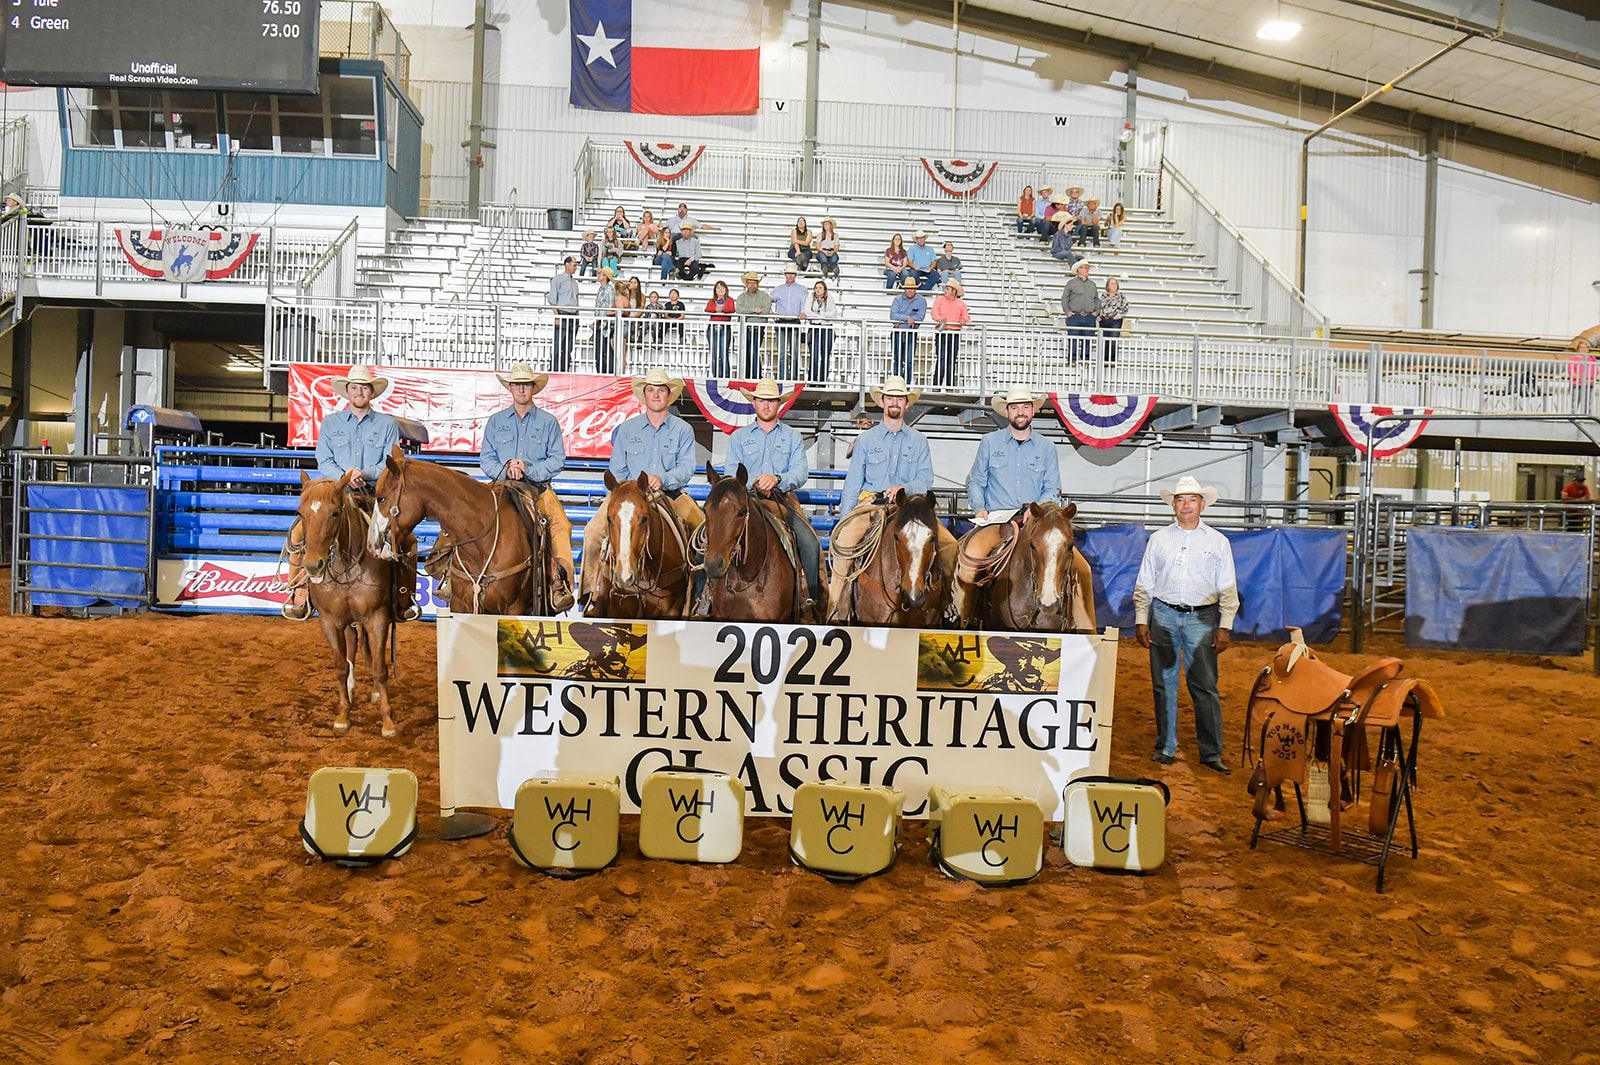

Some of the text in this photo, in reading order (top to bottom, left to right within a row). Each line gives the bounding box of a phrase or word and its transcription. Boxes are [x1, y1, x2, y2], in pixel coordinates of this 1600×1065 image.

[263, 0, 301, 15] 76.50
[11, 16, 300, 38] 4 Green 73.00
[131, 62, 177, 74] Unofficial
[109, 74, 198, 85] Real Screen Video.Com
[776, 101, 785, 111] V
[1055, 116, 1067, 126] W
[217, 204, 229, 216] U
[165, 235, 207, 247] WELCOME
[713, 625, 853, 688] 2022
[452, 679, 1099, 752] WESTERN HERITAGE
